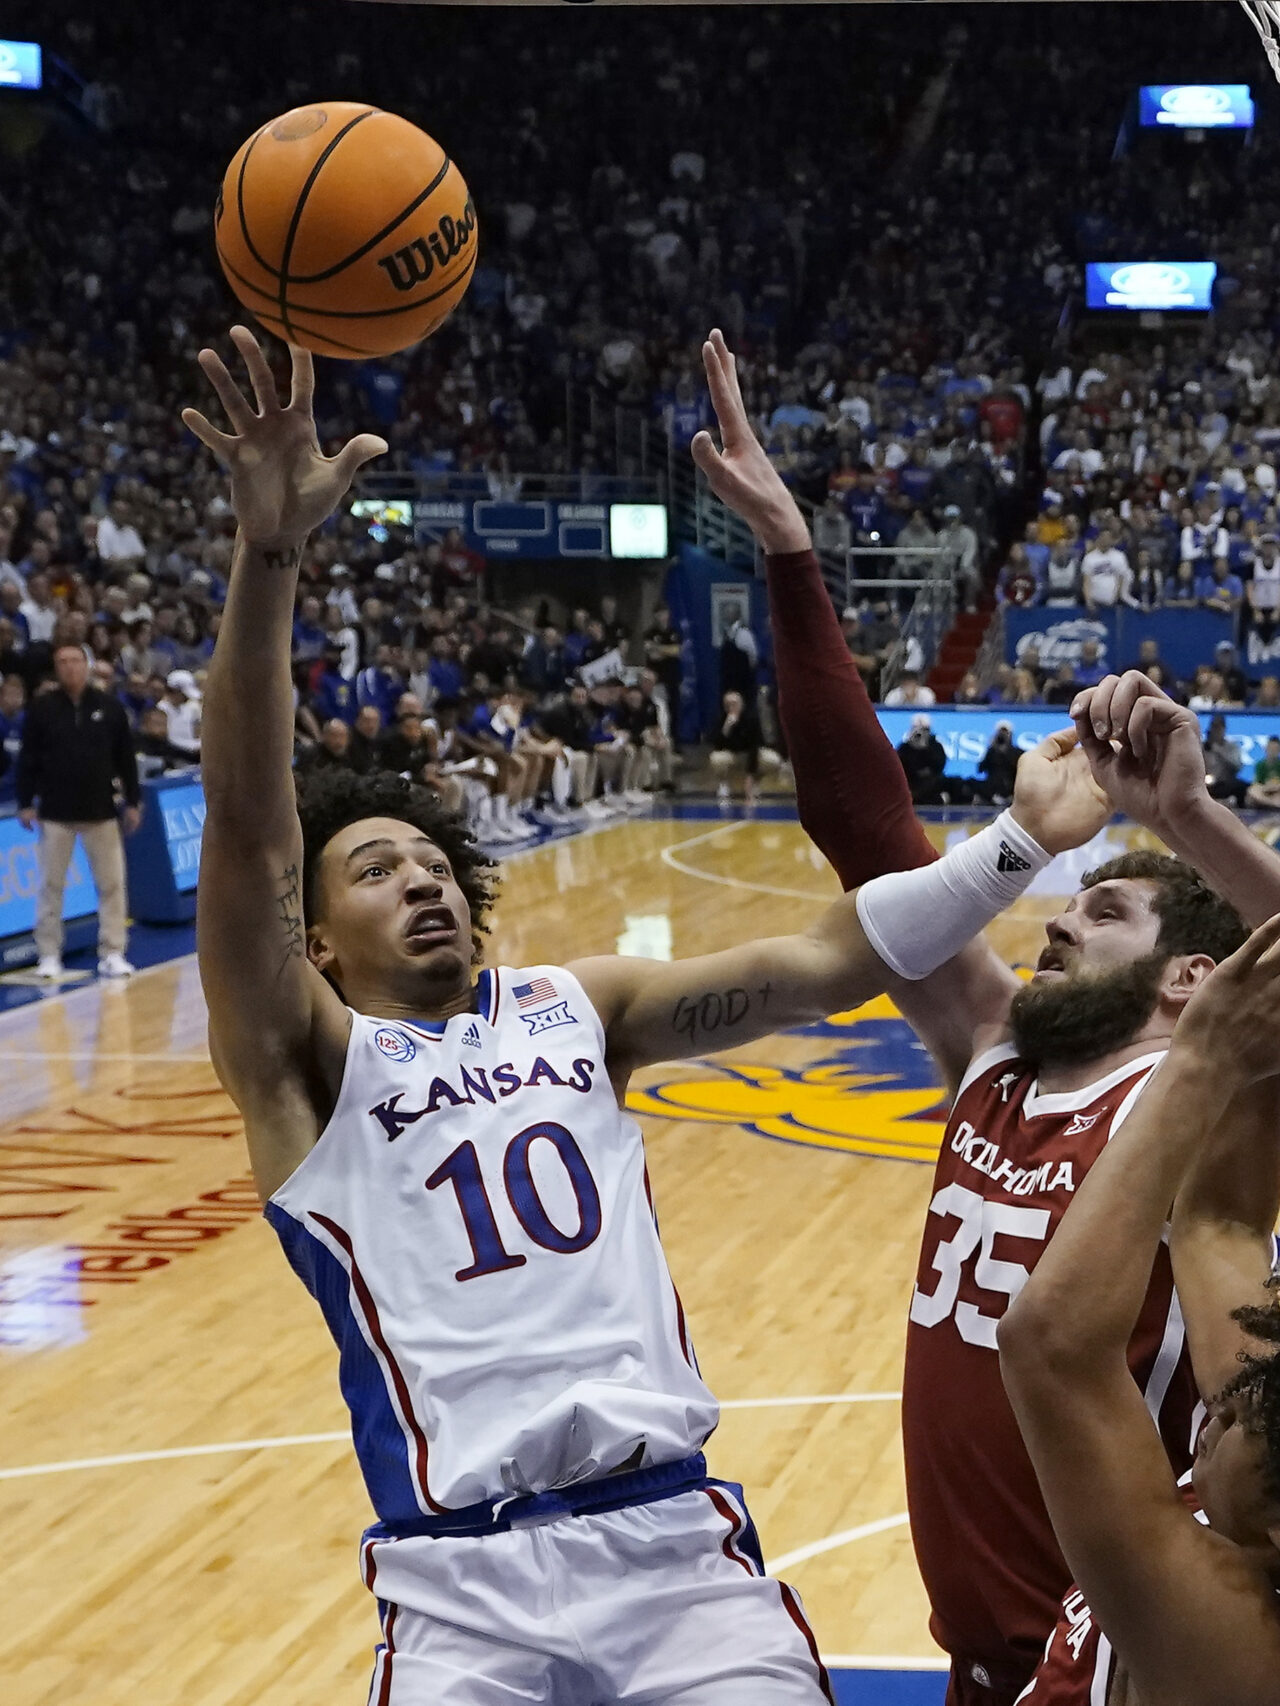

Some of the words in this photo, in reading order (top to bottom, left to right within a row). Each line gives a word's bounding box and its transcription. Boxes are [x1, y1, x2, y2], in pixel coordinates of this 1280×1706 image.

[378, 201, 476, 291] Wilso
[378, 1035, 398, 1051] 125
[672, 988, 750, 1046] GOD
[369, 1057, 595, 1142] KANSAS
[425, 1121, 602, 1282] 10
[910, 1182, 1052, 1351] 35
